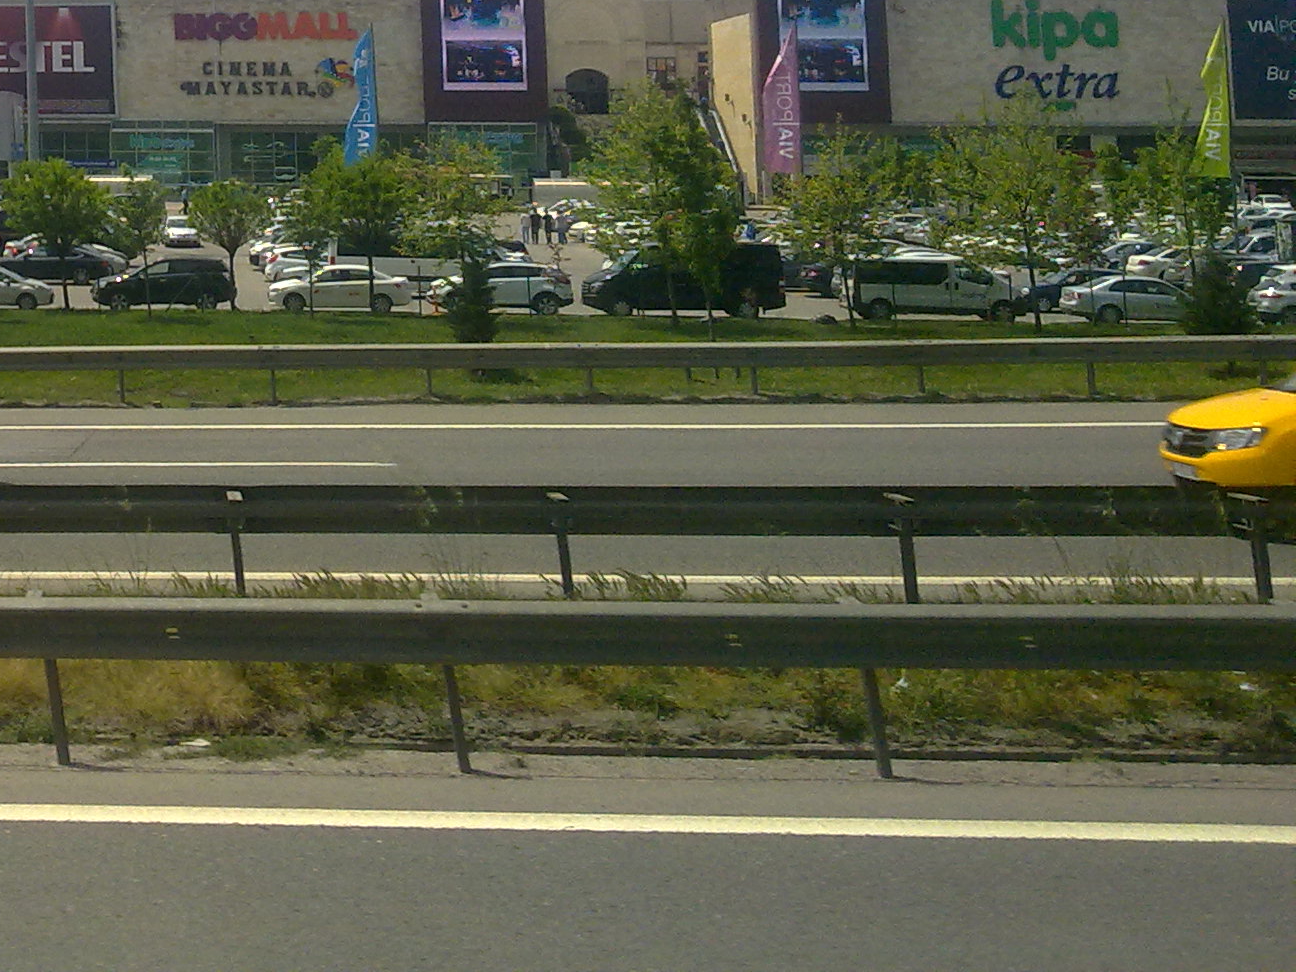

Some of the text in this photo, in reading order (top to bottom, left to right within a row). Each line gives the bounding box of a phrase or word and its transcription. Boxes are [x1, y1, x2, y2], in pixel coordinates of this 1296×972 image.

[202, 61, 292, 77] CINEMA
[1267, 66, 1290, 81] Bu
[180, 80, 317, 98] MAYASTAR
[995, 64, 1121, 99] extra
